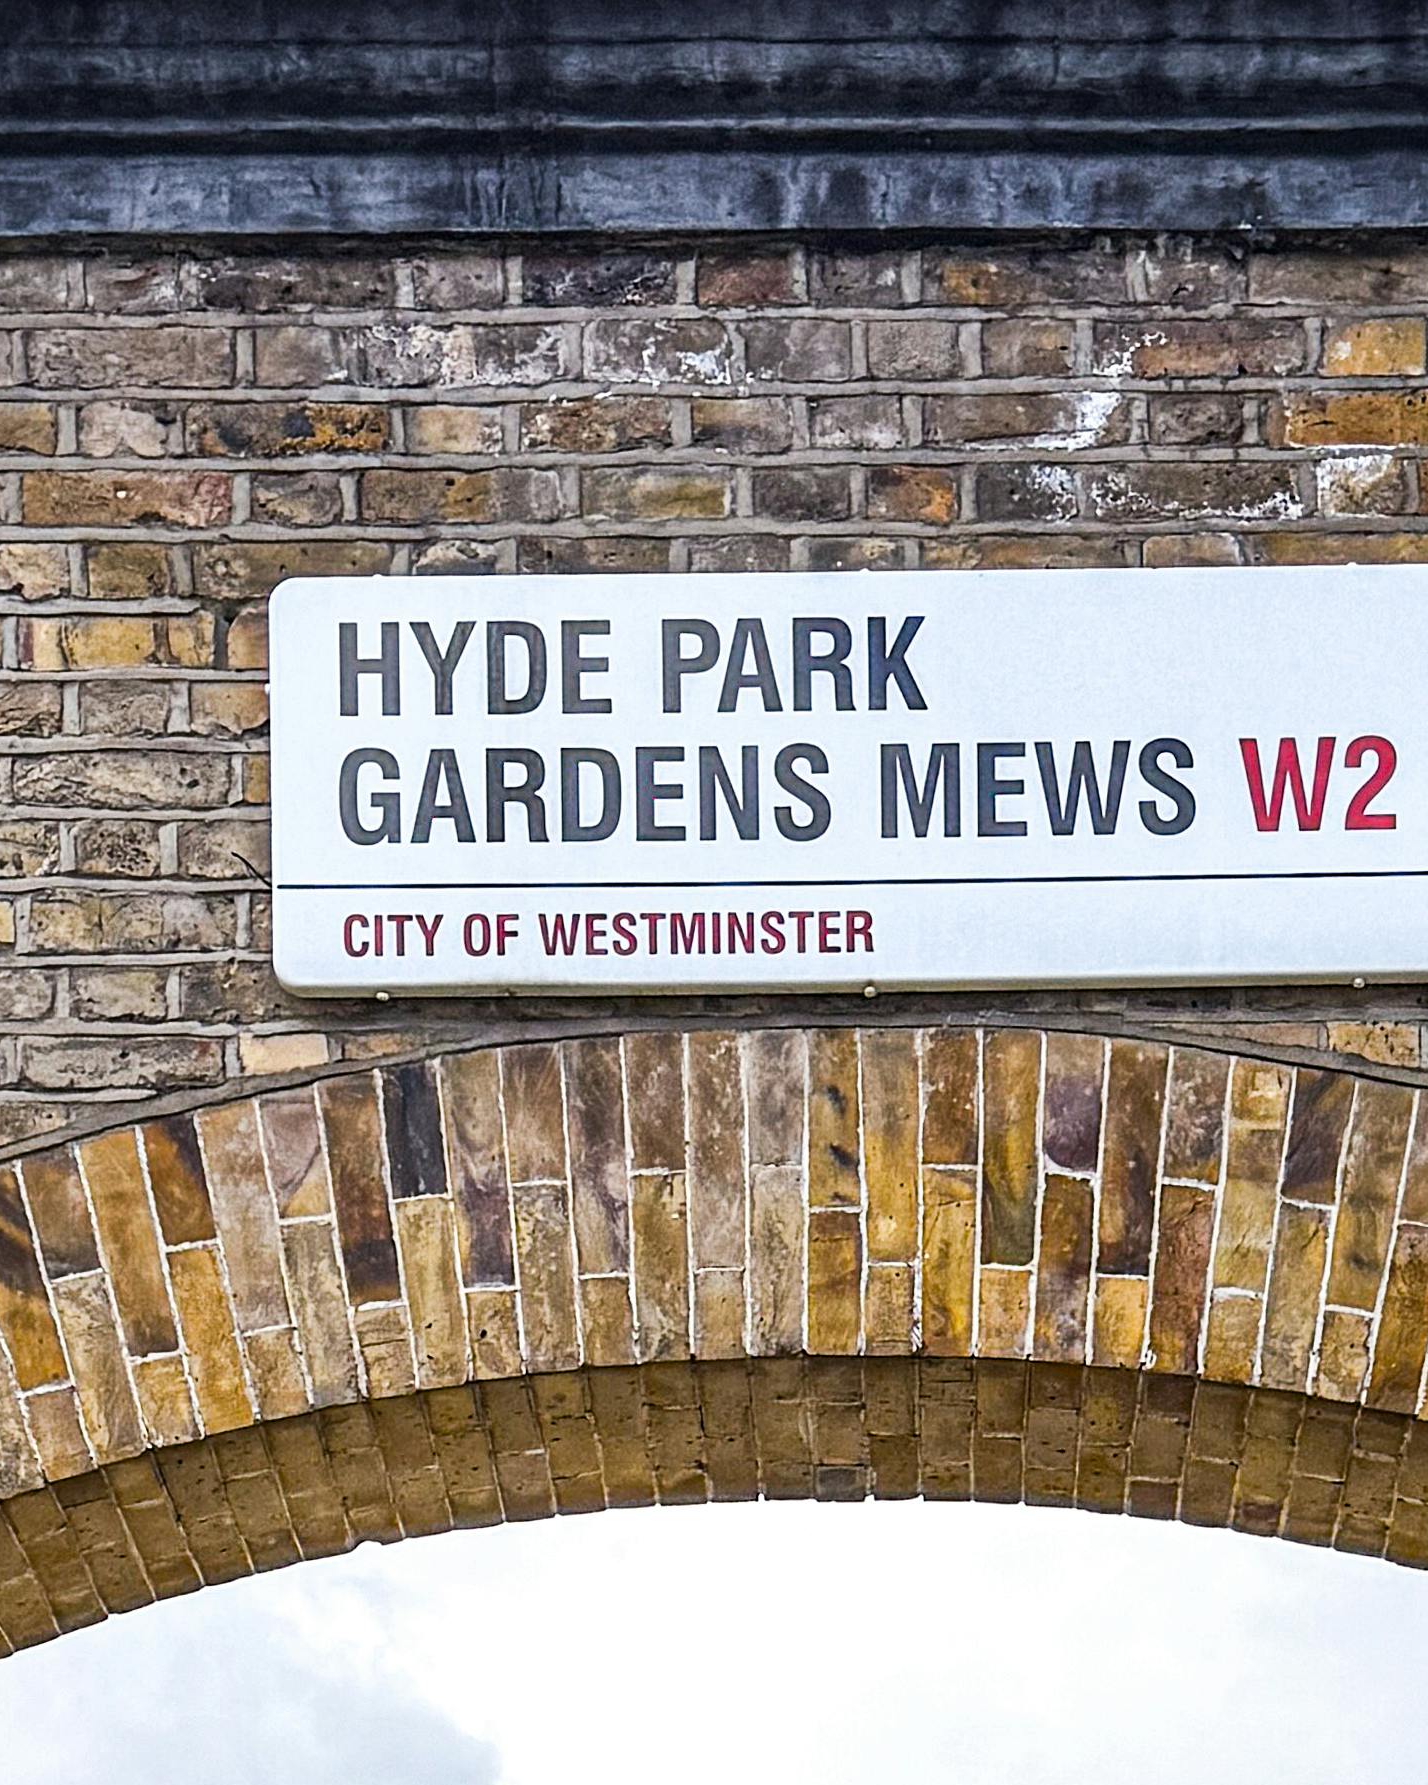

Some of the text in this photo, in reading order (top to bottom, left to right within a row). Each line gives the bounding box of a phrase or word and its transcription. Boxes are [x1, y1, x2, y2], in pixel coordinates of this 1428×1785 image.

[339, 616, 928, 716] HYDE PARK
[339, 735, 1397, 845] GARDENS MEWS W2
[344, 911, 874, 957] CITY OF WESTMINSTER
